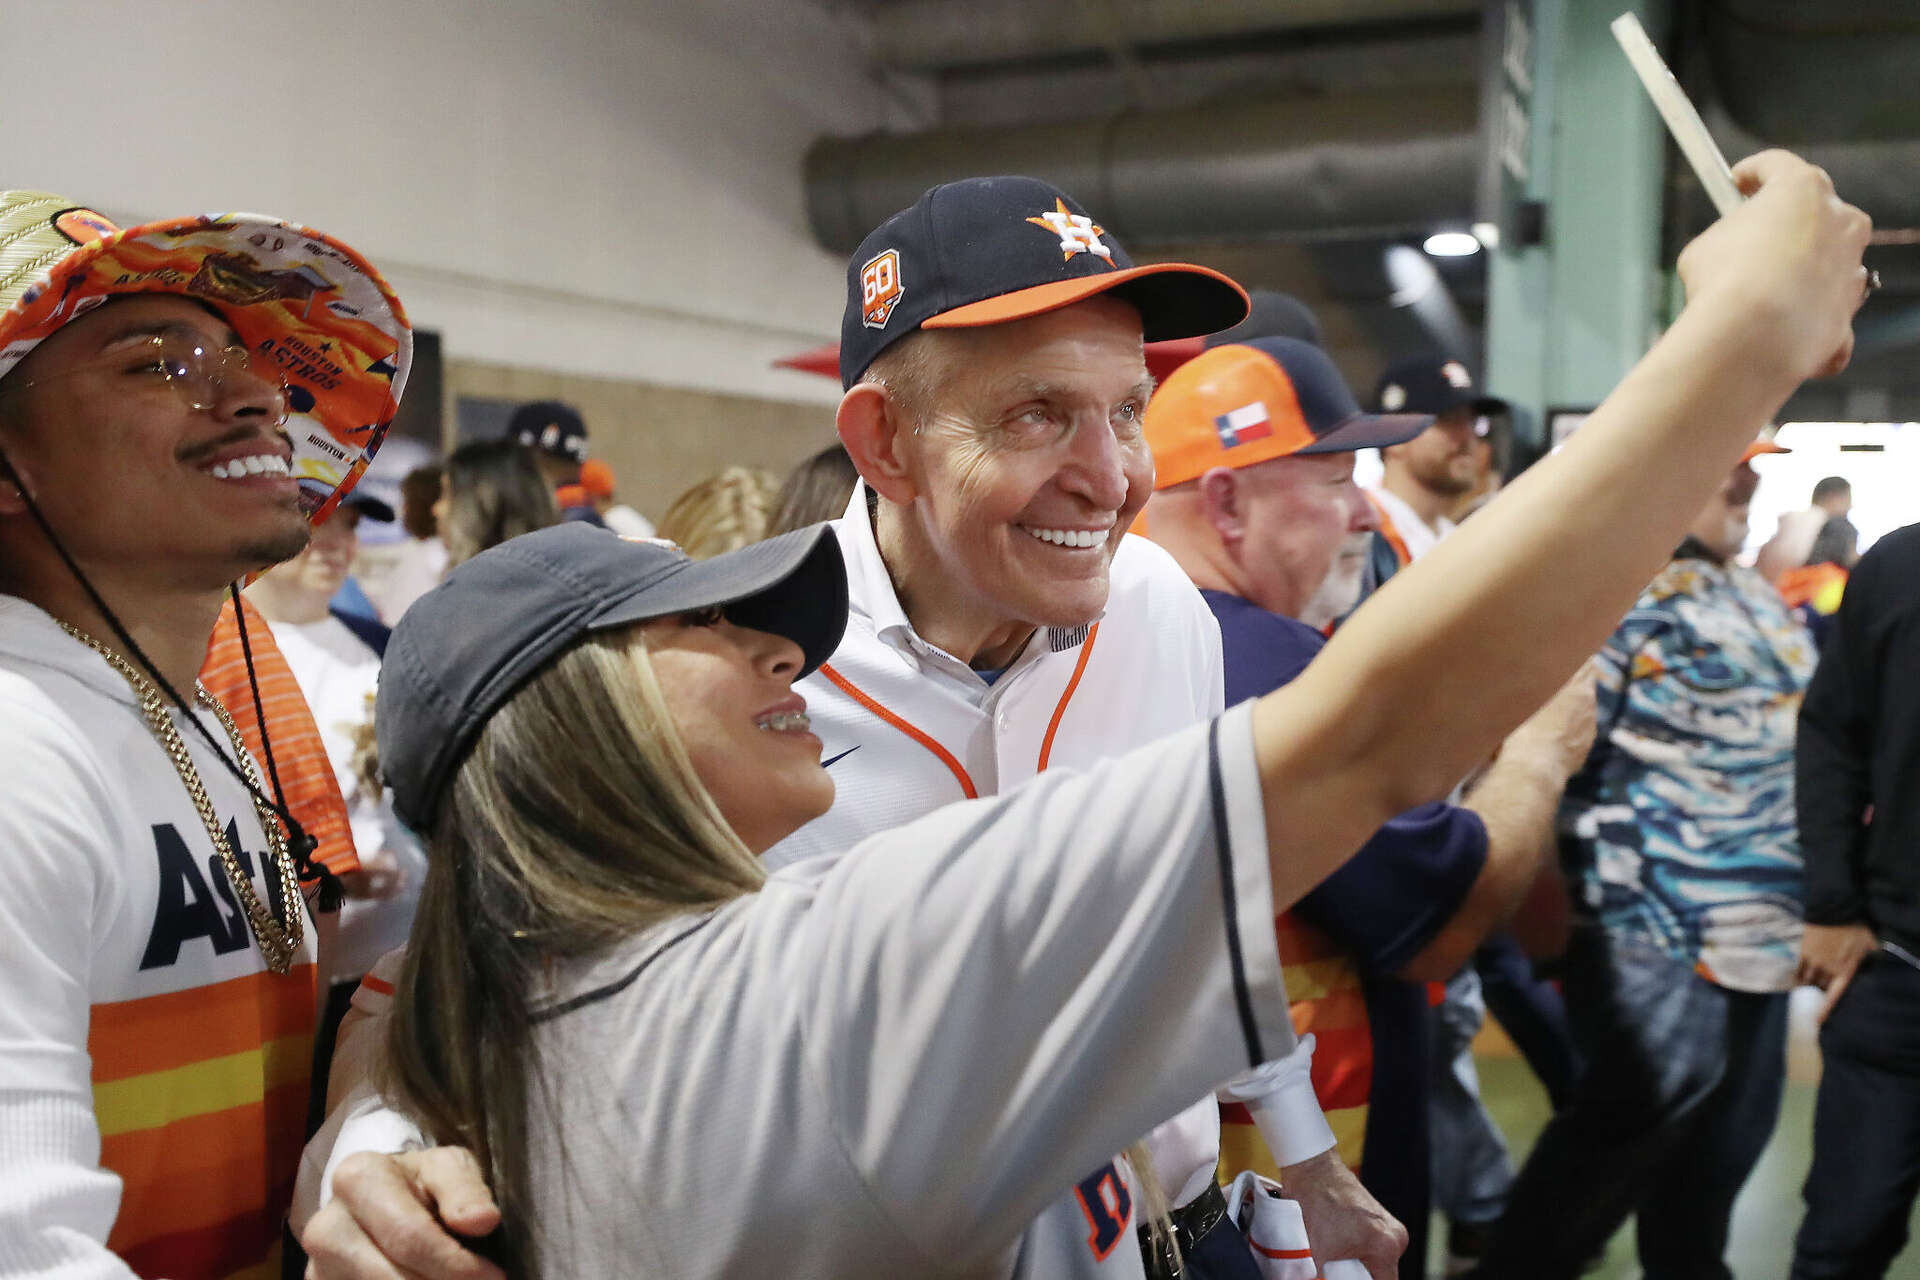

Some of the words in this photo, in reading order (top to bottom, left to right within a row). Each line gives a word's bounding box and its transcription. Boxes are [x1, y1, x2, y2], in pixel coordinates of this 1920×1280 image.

[1042, 211, 1111, 257] H
[864, 257, 893, 306] 60
[259, 339, 342, 390] ASTROS
[283, 336, 343, 376] HOUSTON
[306, 434, 345, 461] HOUSTON
